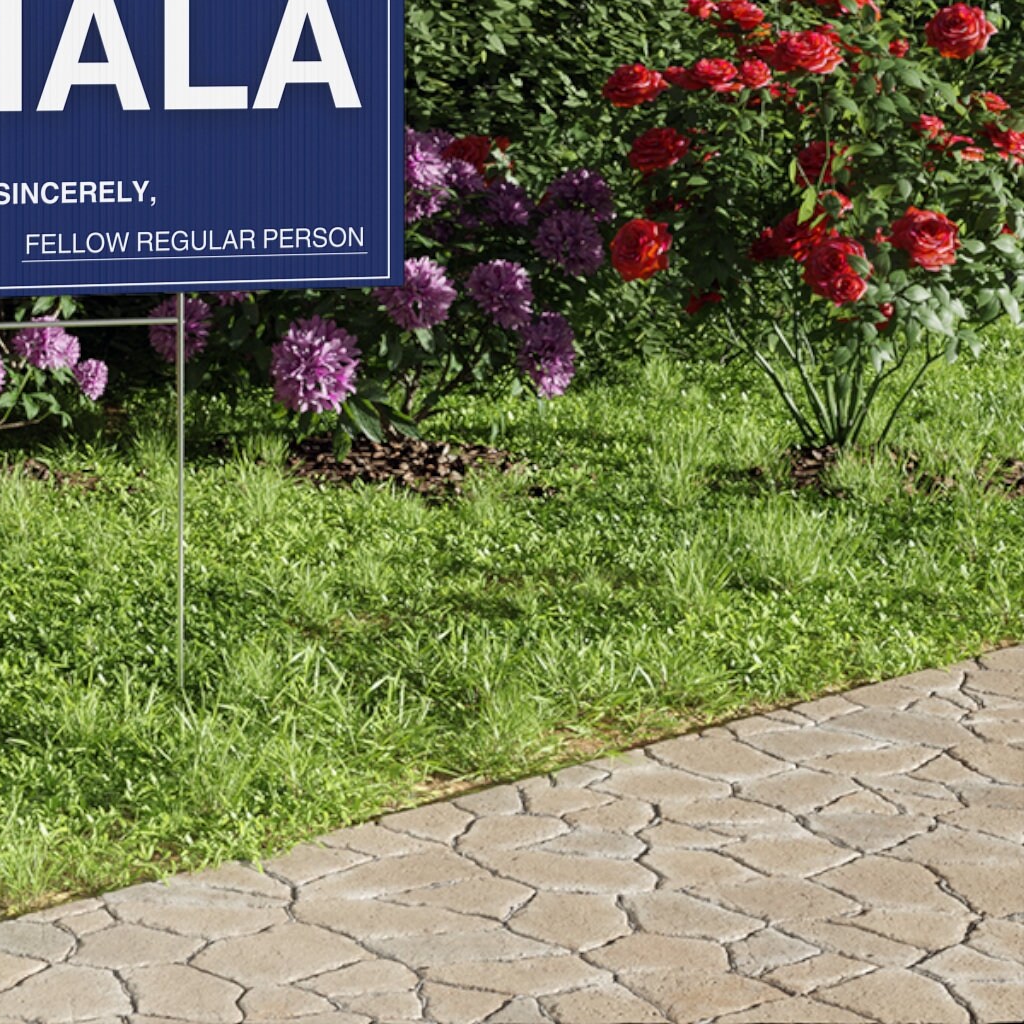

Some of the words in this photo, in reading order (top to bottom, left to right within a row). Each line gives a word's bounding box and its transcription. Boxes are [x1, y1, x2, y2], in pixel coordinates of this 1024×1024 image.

[26, 231, 130, 255] FELLOW
[137, 229, 256, 252] REGULAR
[263, 226, 365, 249] PERSON
